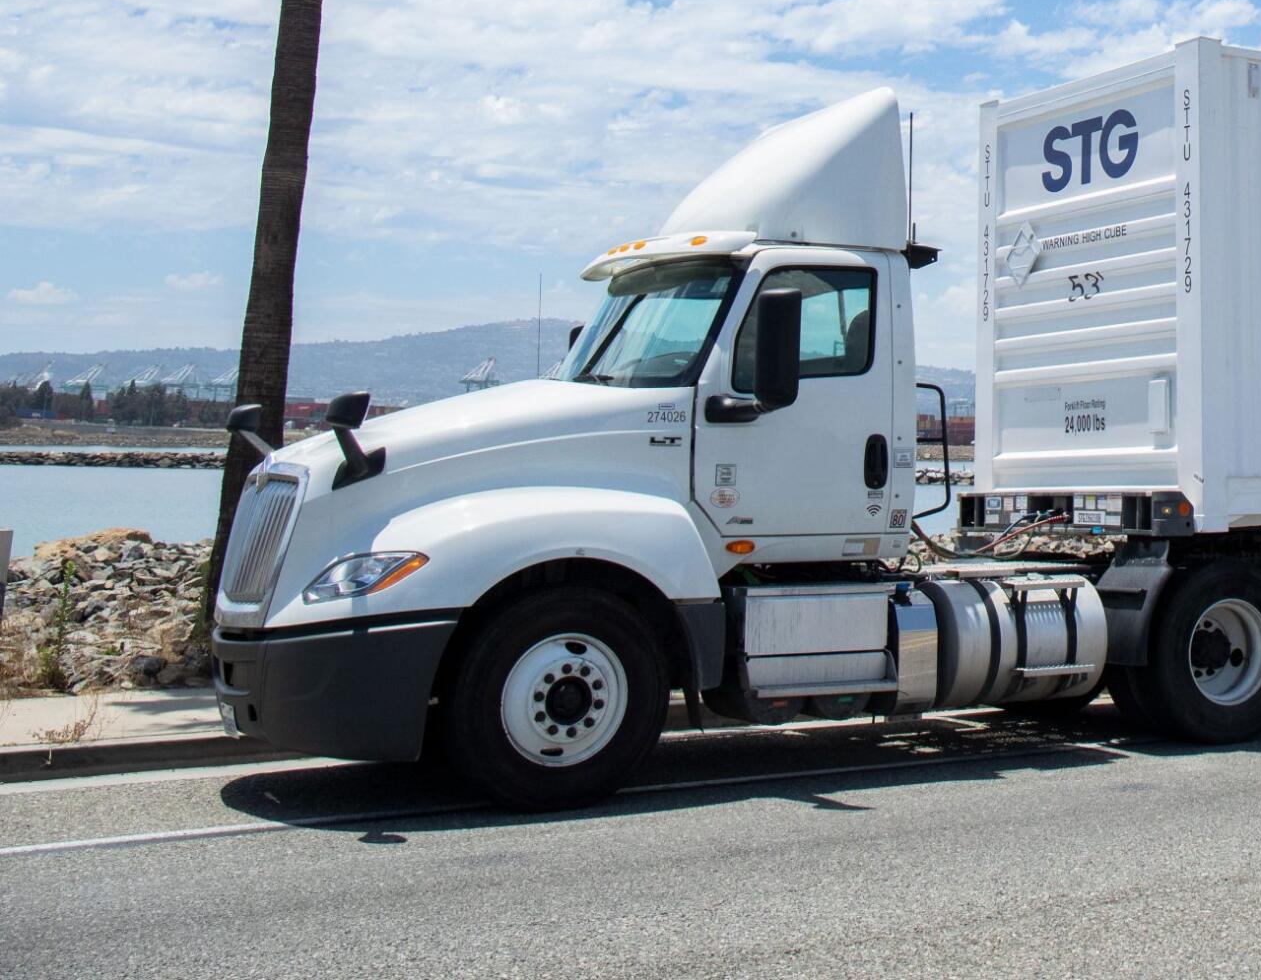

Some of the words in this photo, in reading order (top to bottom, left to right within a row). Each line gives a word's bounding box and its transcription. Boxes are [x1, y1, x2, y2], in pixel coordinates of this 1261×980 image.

[1041, 108, 1139, 193] STG
[1183, 89, 1191, 161] STTU
[982, 224, 990, 322] 431729
[1042, 233, 1080, 251] WARNING
[1082, 230, 1102, 244] HIGH
[1104, 224, 1127, 240] CUBE
[1183, 182, 1192, 293] 431729
[647, 410, 686, 423] 274026
[1065, 414, 1092, 436] 24,000
[1092, 413, 1106, 431] lbs
